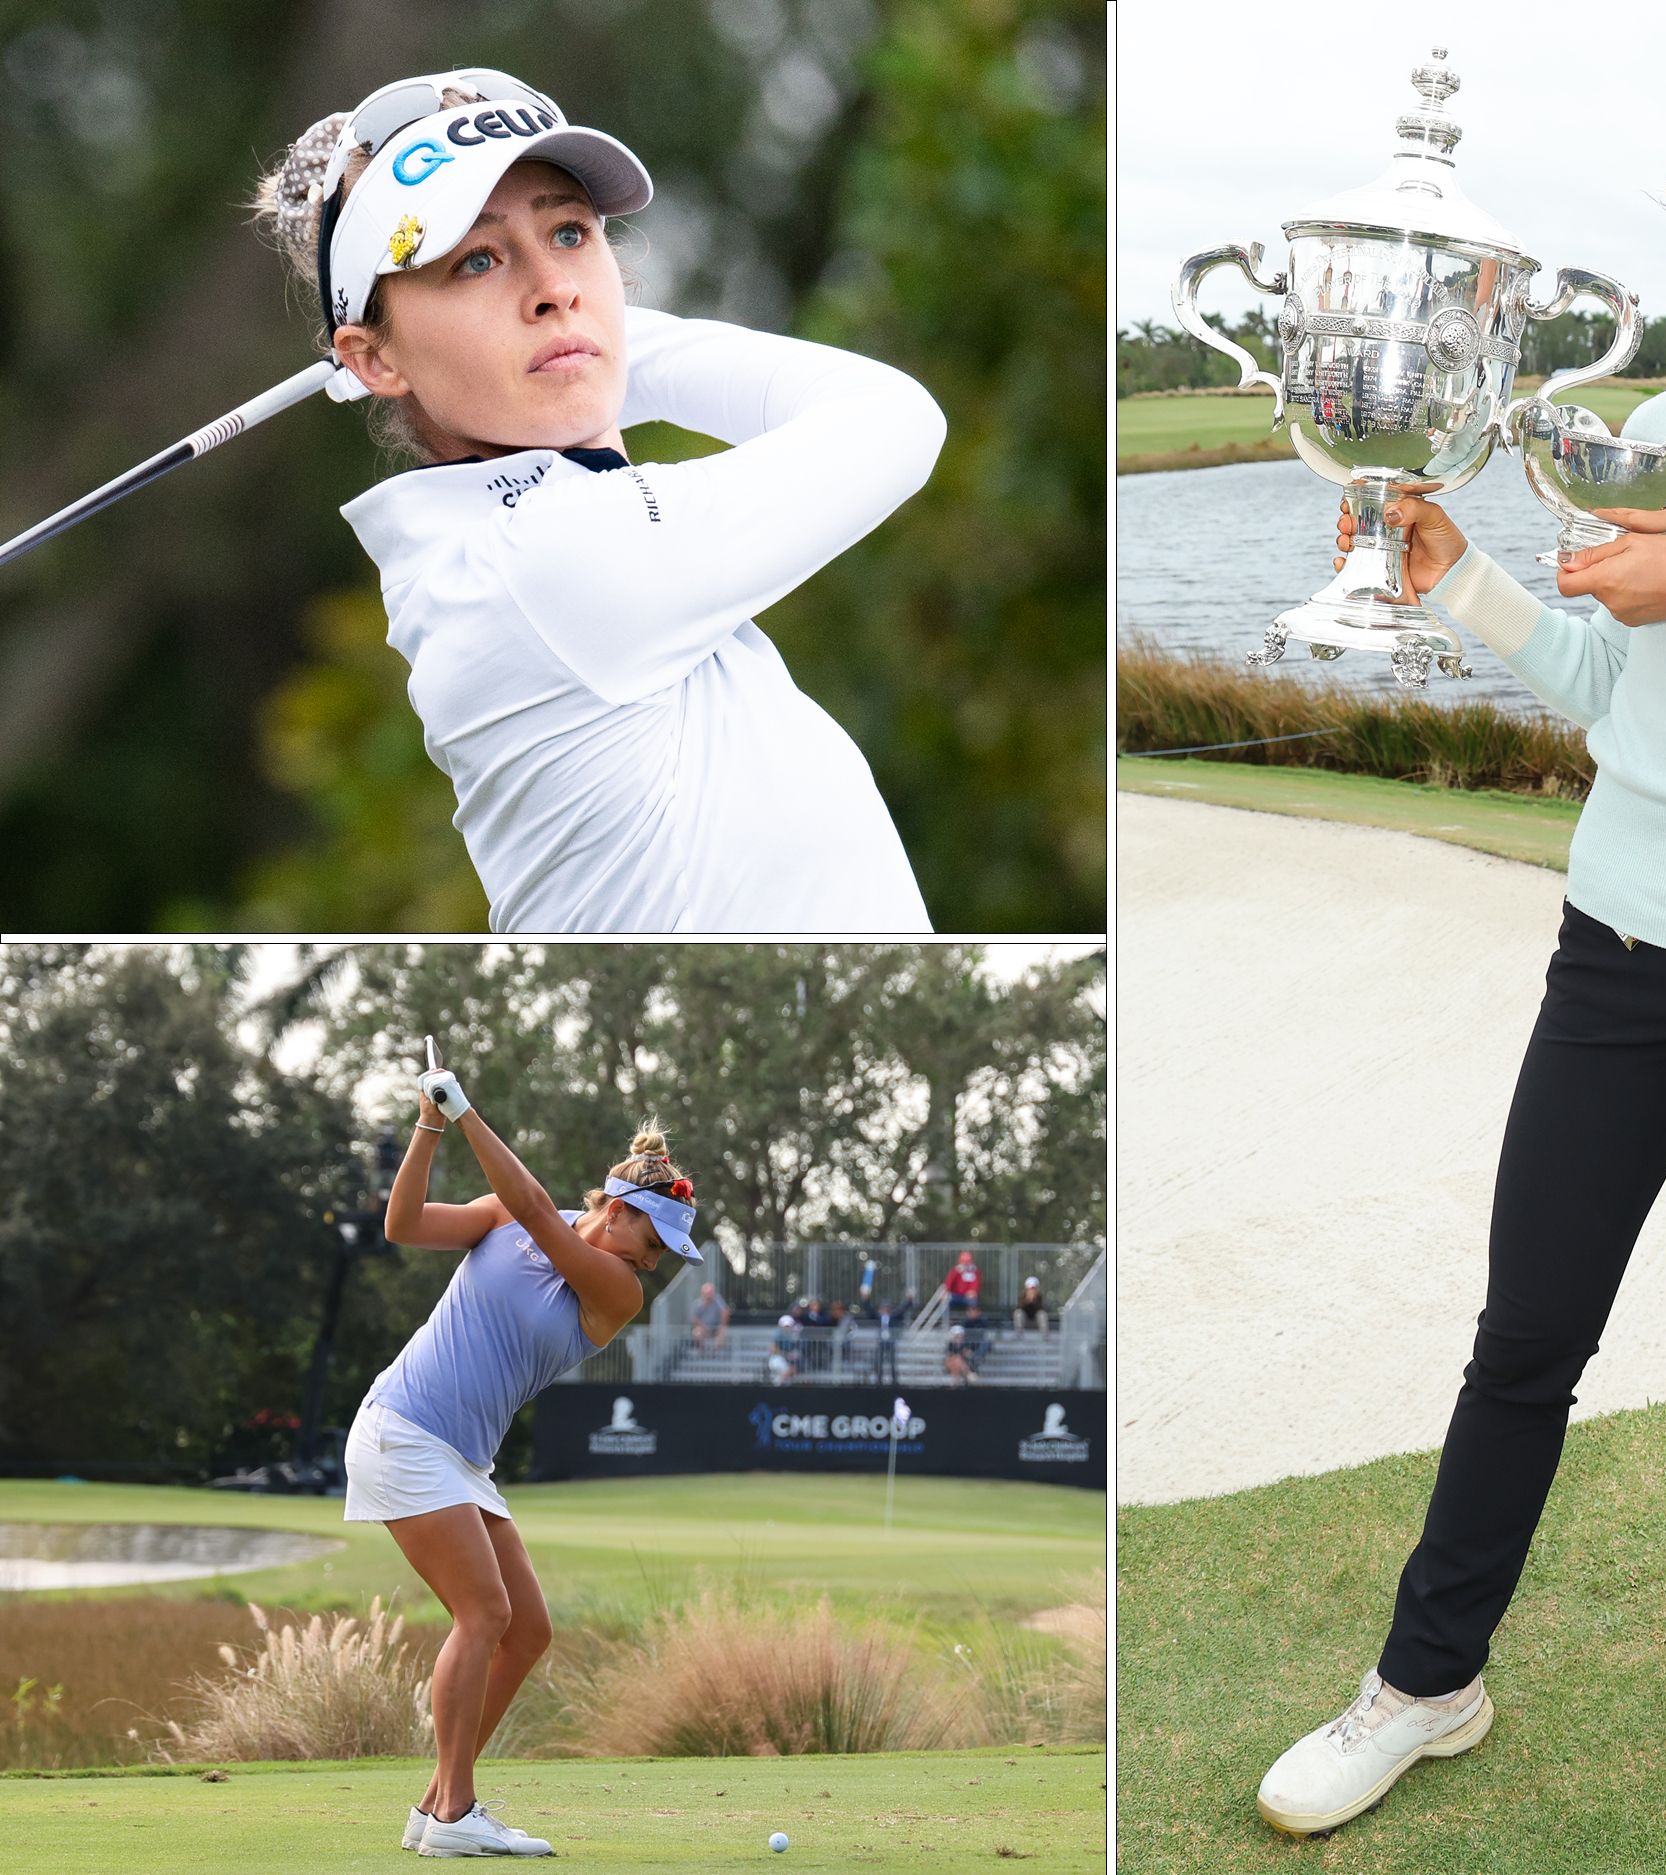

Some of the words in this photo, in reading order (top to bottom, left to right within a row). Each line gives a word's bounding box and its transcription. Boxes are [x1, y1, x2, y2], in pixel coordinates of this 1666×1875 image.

[515, 1238, 540, 1262] UKG
[772, 1413, 830, 1438] CME
[830, 1414, 927, 1440] GROUP
